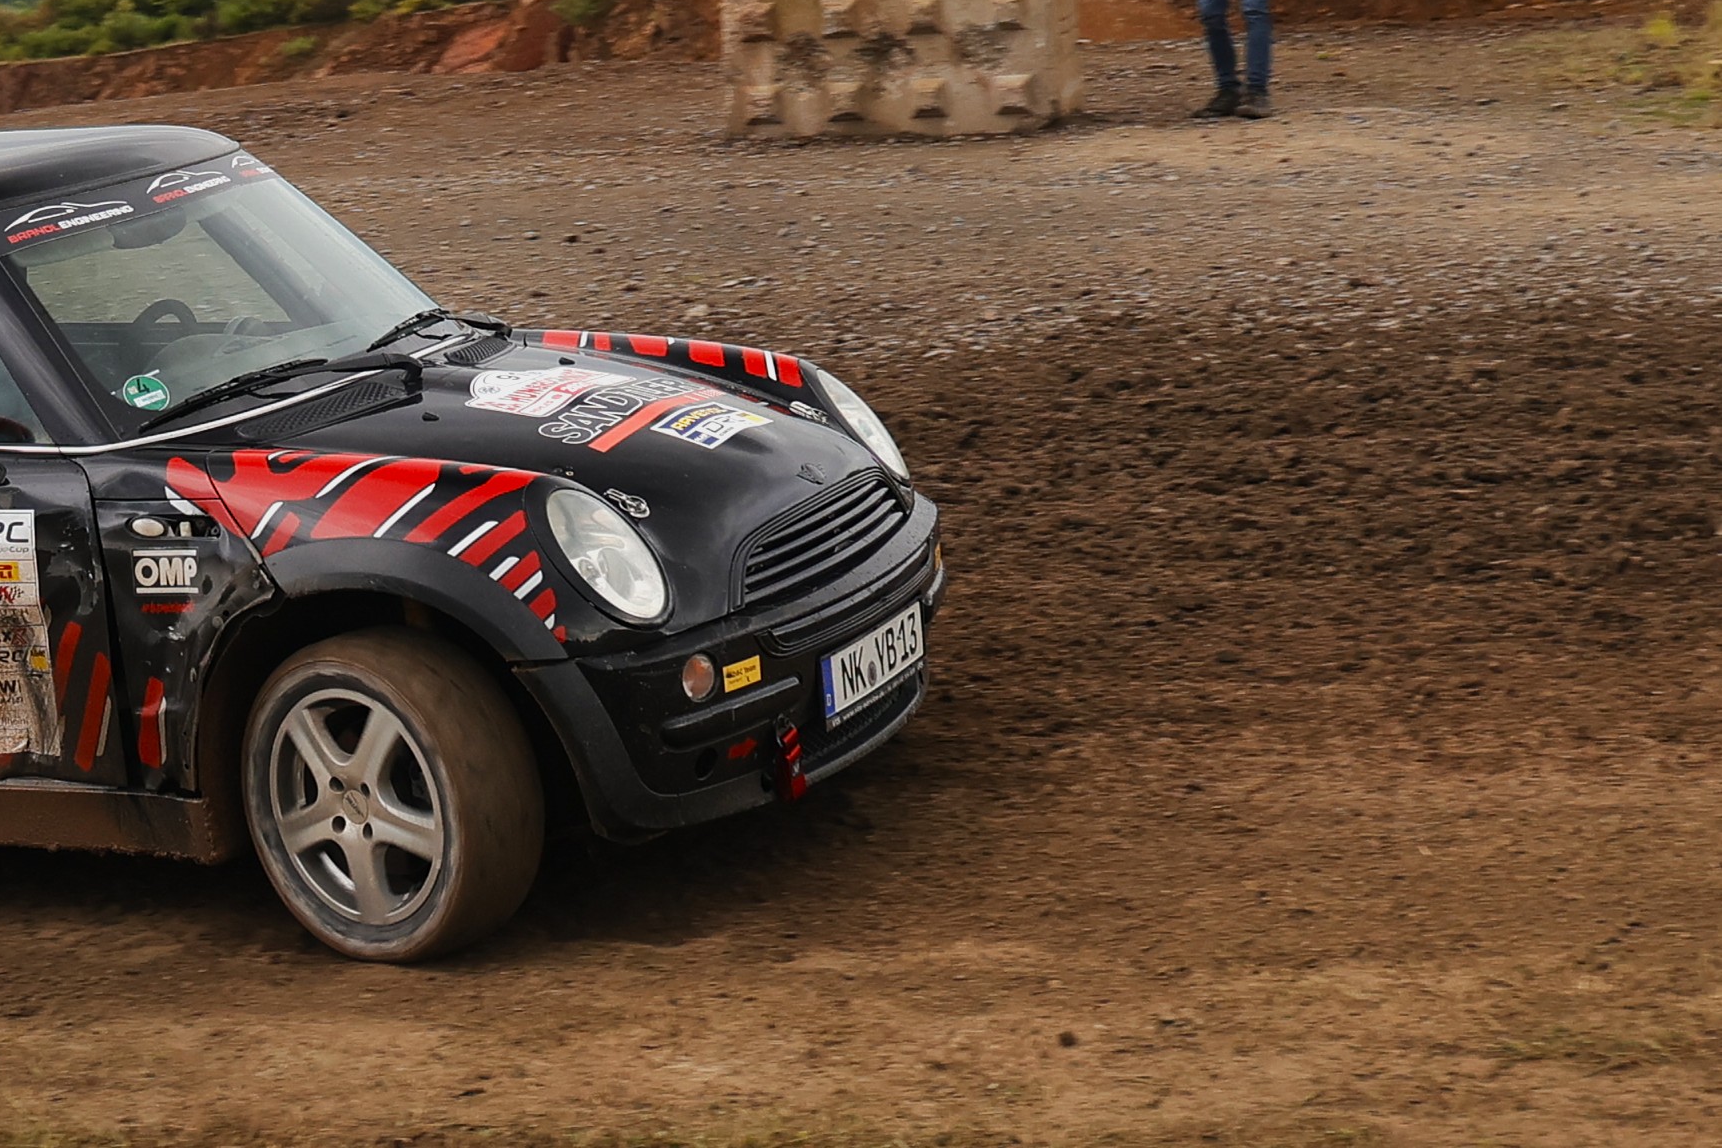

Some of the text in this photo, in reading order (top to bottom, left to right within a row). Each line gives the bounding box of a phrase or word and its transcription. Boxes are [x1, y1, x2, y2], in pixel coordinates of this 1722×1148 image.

[136, 378, 150, 393] 4
[134, 557, 197, 587] OMP
[841, 645, 868, 701] NK
